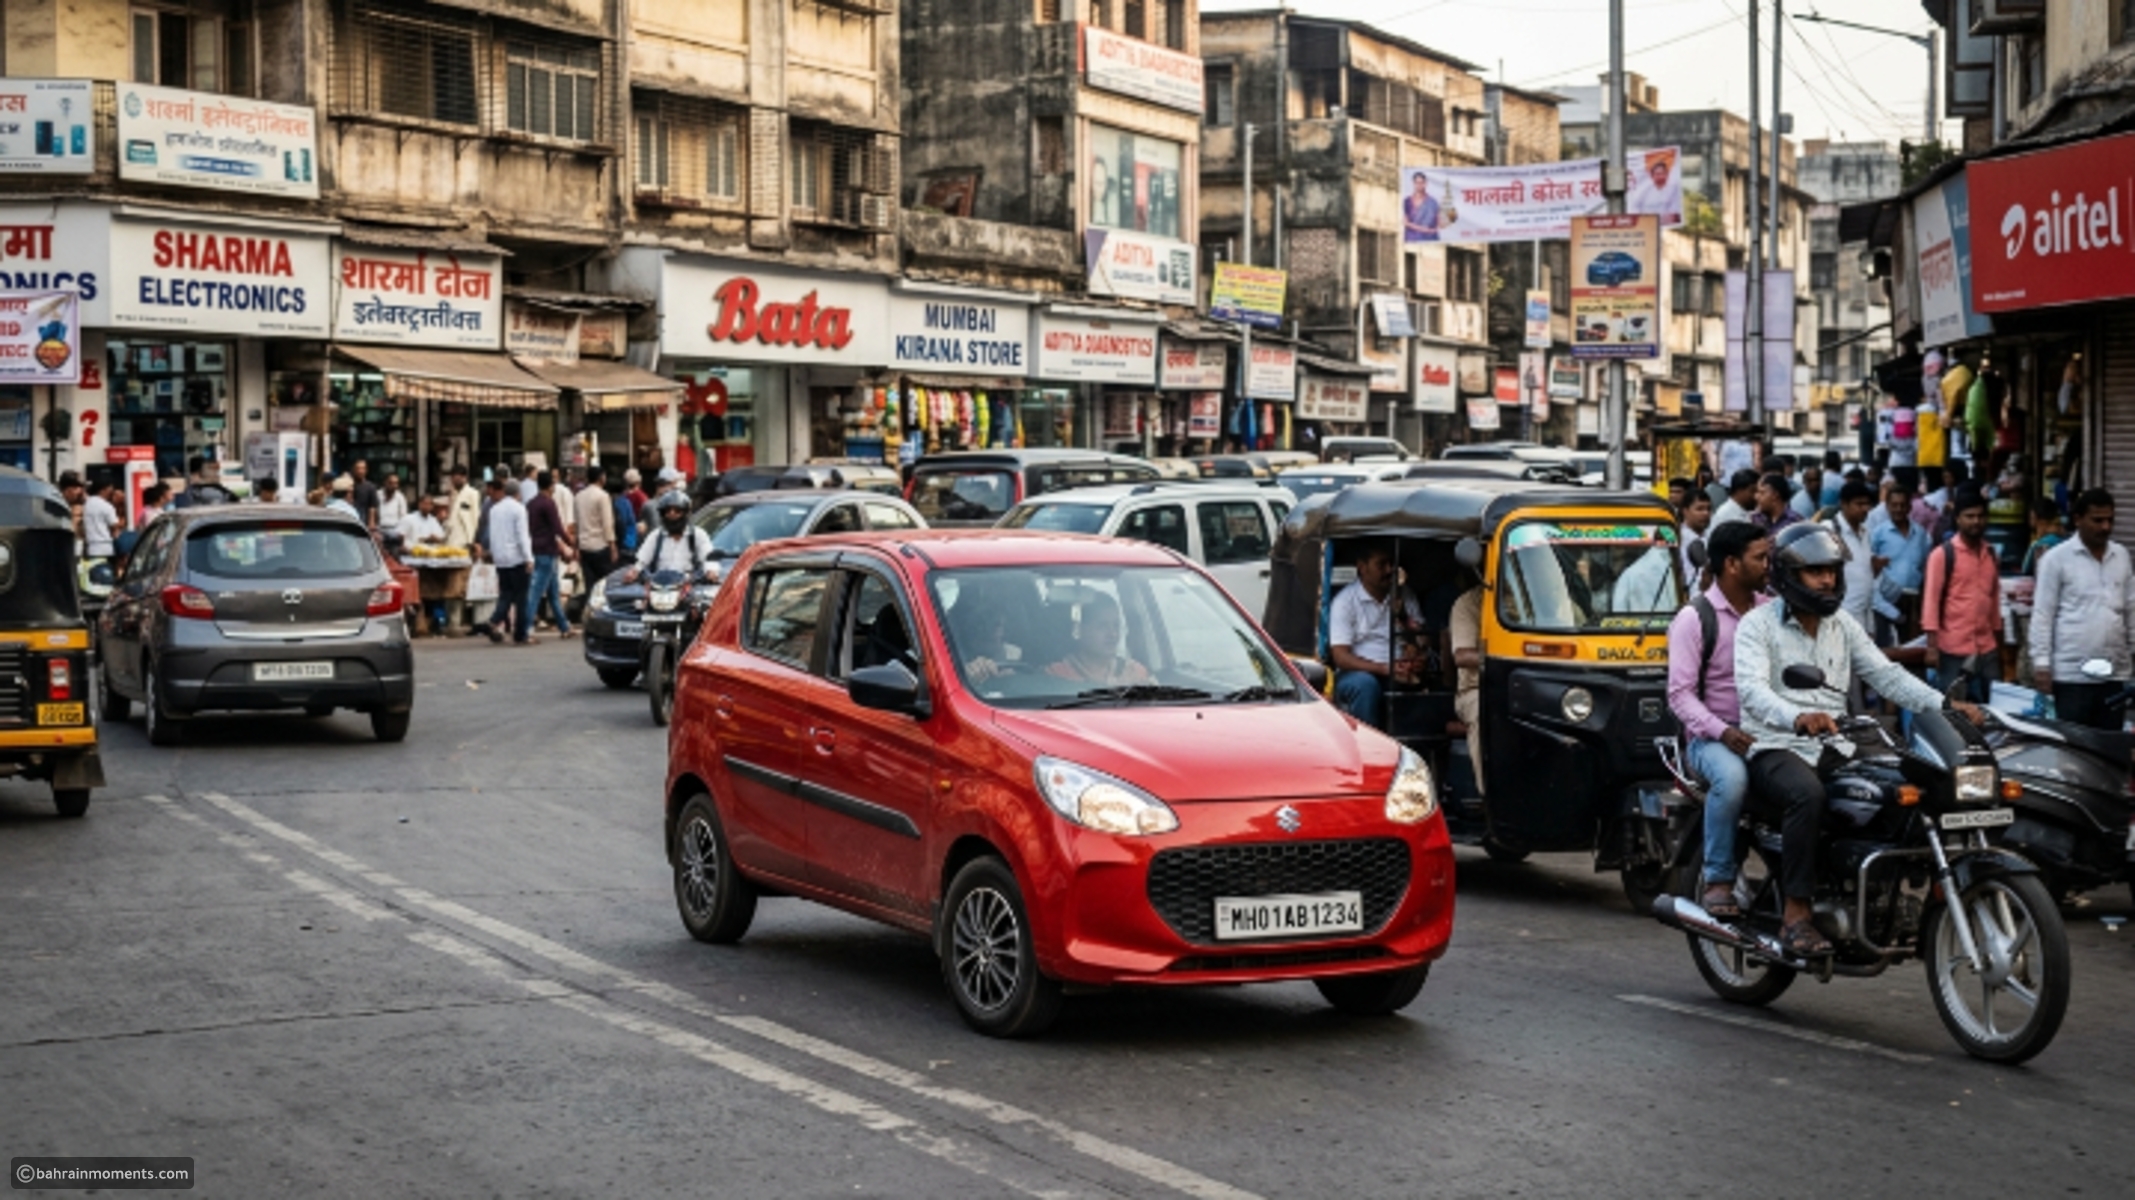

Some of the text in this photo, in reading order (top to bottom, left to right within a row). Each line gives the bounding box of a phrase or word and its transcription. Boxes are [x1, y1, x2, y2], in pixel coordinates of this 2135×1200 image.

[2033, 186, 2123, 256] airtel
[153, 229, 294, 277] SHARMA
[139, 276, 306, 314] ELECTRONICS
[707, 276, 854, 350] Bata
[924, 303, 996, 333] MUMBAI
[896, 335, 1022, 367] KIRANA STORE
[1231, 901, 1358, 931] MH01AB1234
